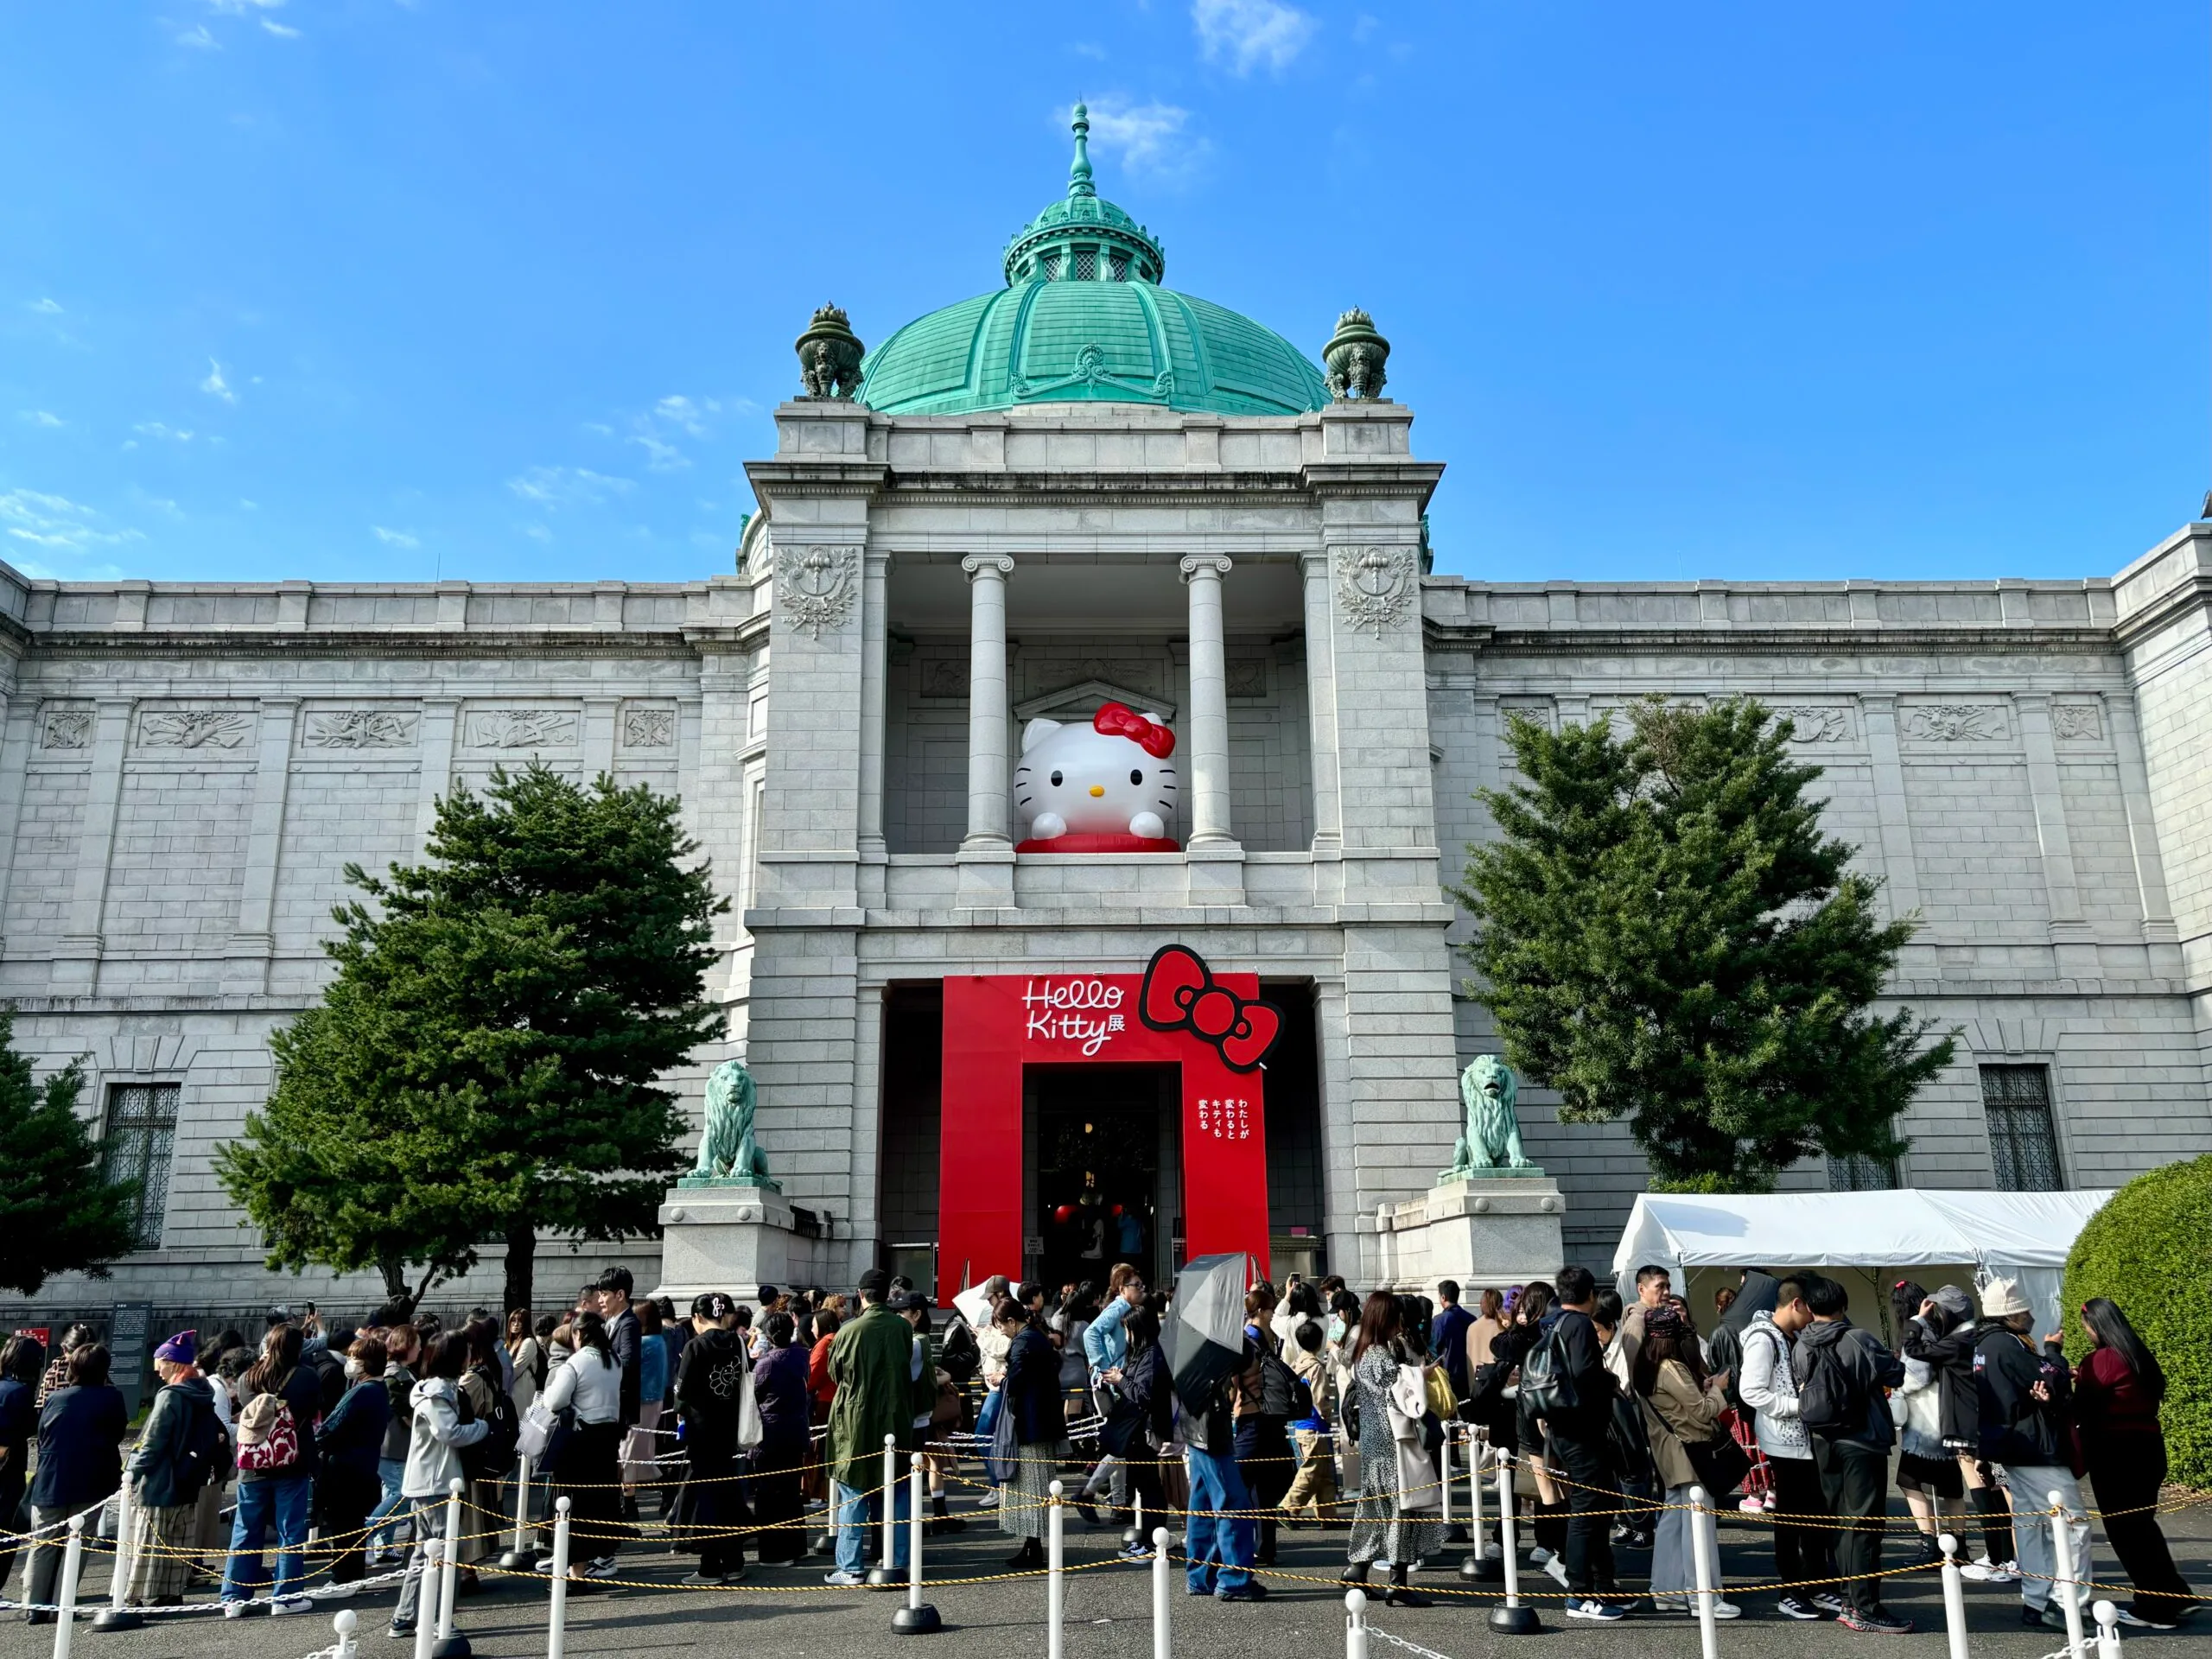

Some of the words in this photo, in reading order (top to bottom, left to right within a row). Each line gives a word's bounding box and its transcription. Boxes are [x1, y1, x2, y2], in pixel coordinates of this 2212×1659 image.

[1022, 980, 1124, 1010] Hello
[1027, 1010, 1111, 1057] Kitty
[1107, 1014, 1125, 1032] 展
[1198, 1099, 1208, 1129] 変わる
[1211, 1099, 1222, 1138] キティも
[1224, 1099, 1235, 1139] 変わると
[1238, 1099, 1250, 1139] わたしが
